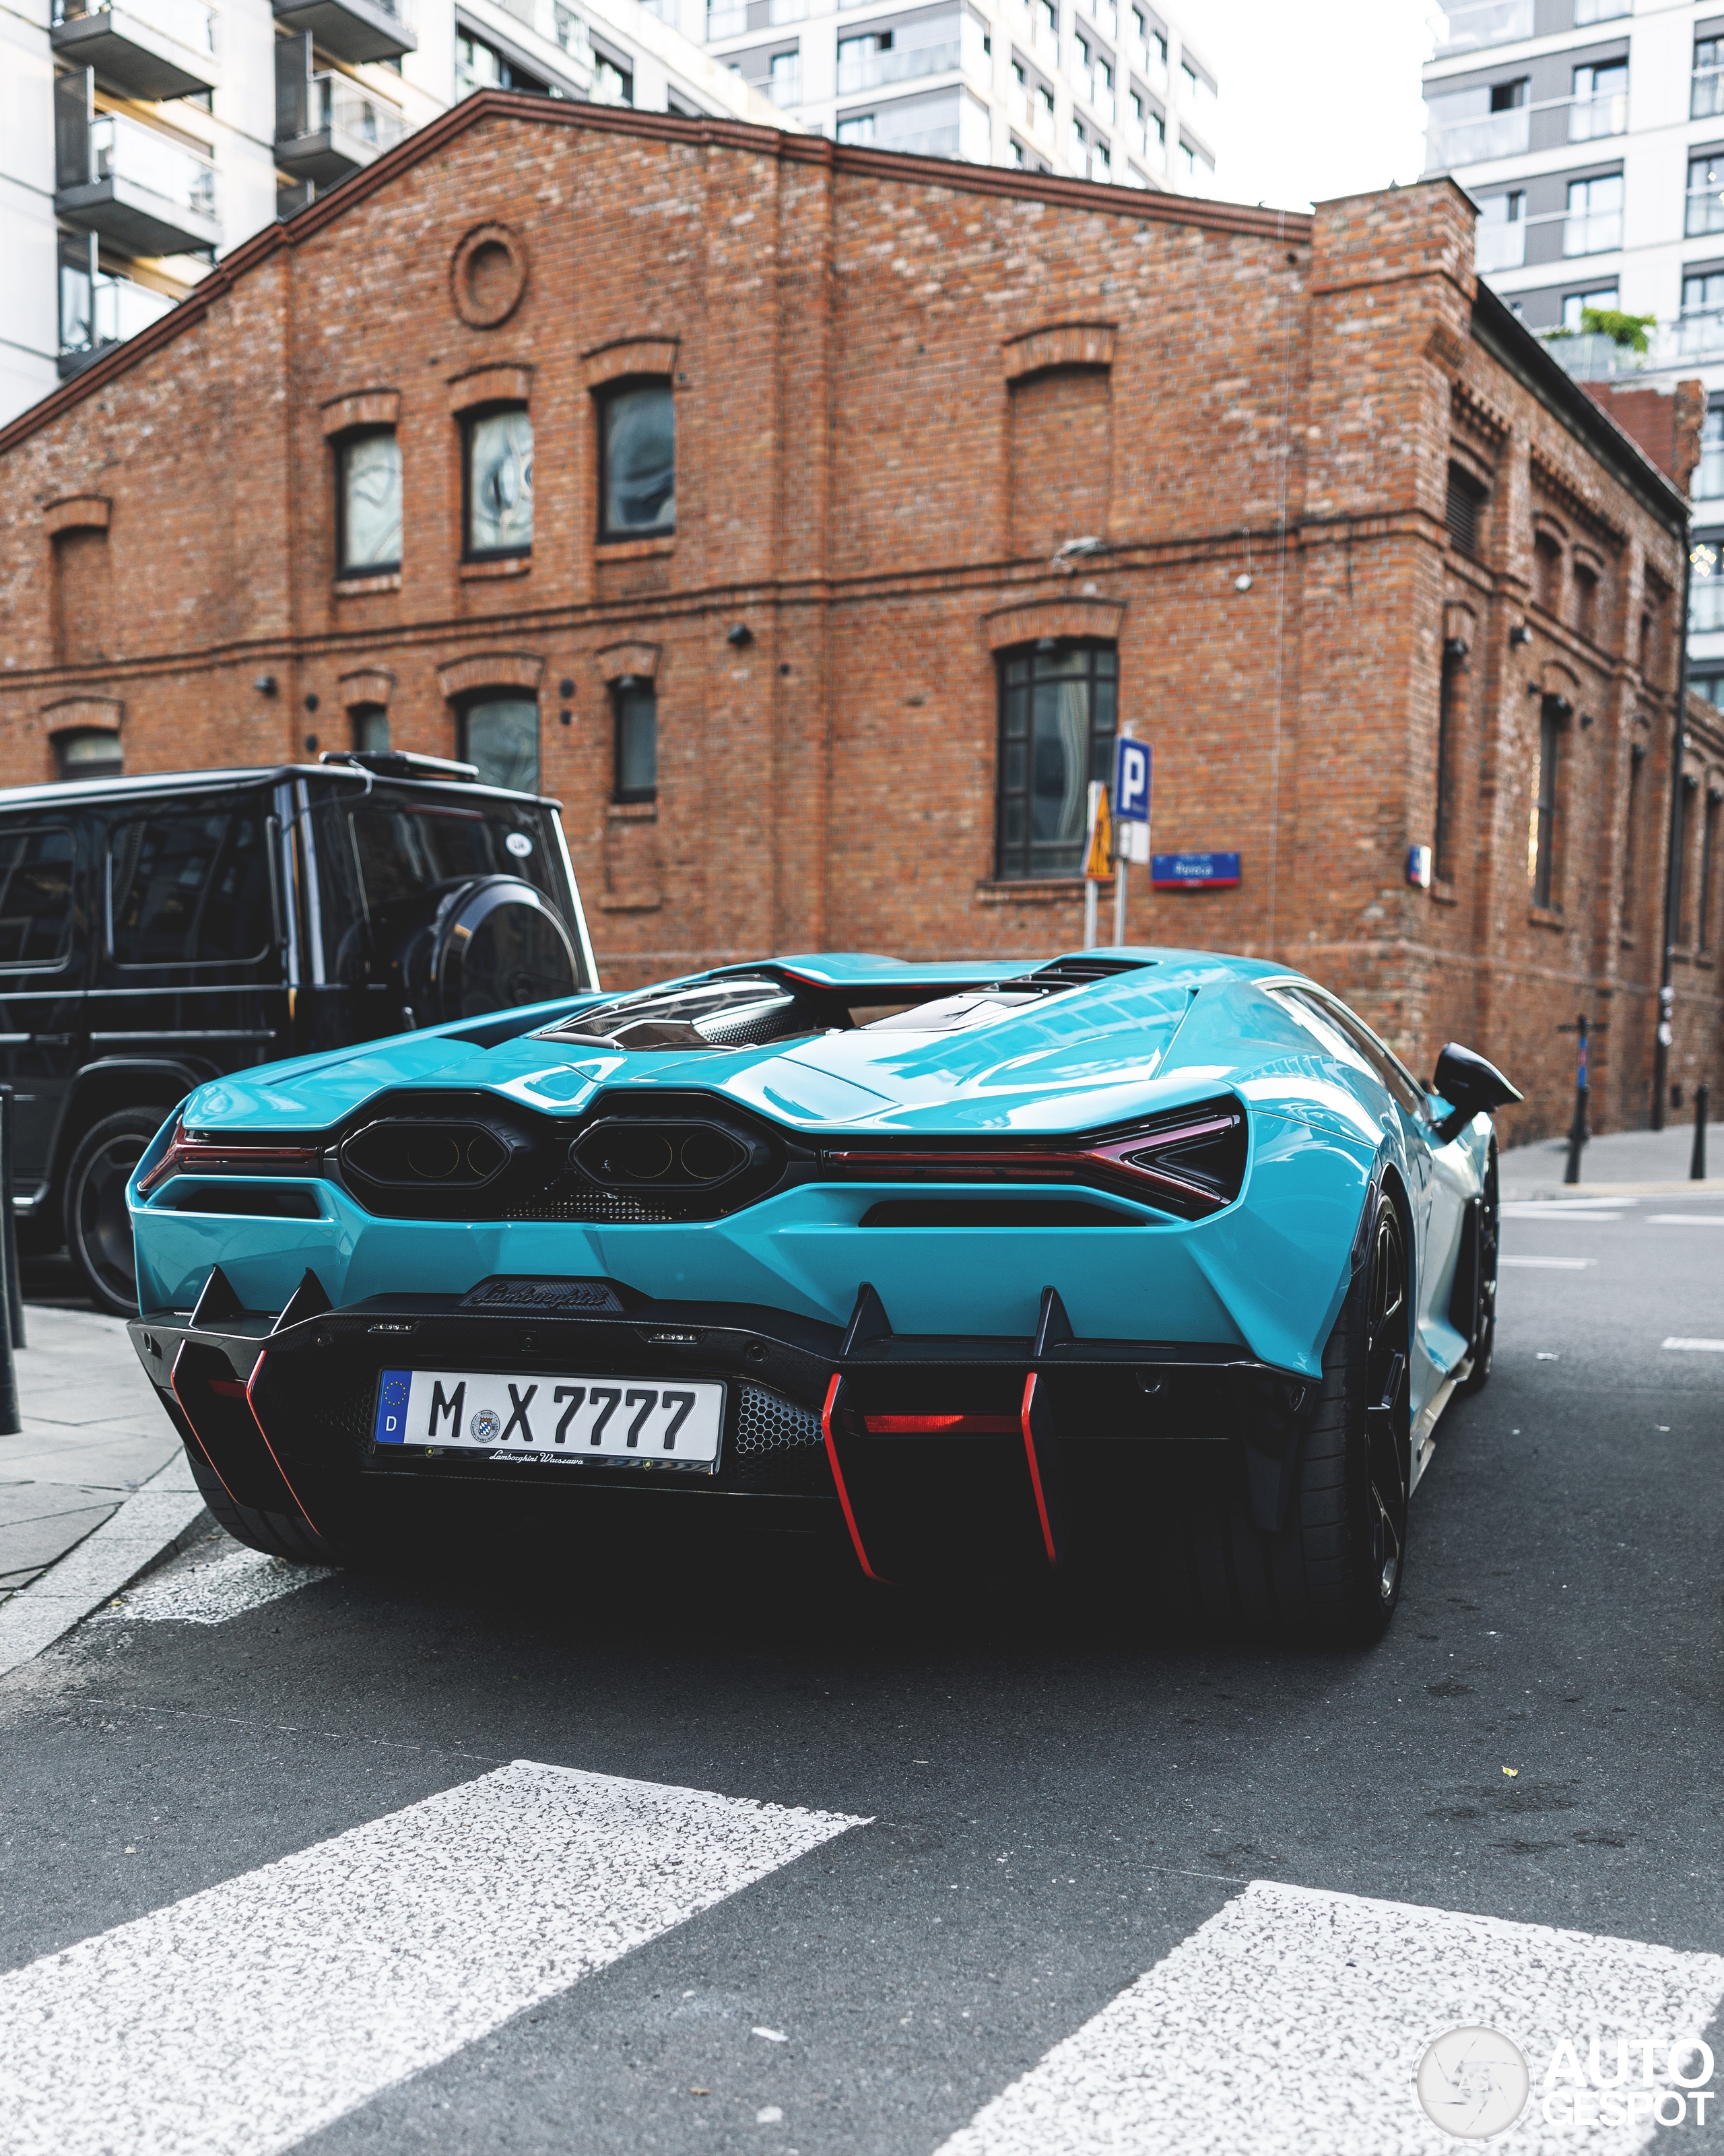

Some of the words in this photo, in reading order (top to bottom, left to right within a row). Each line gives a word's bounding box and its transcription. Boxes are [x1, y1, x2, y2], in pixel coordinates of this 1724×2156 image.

[1123, 748, 1145, 810] P
[471, 1282, 608, 1307] Lamborghini
[386, 1416, 397, 1431] D
[428, 1380, 466, 1438] M
[554, 1385, 696, 1449] 7777
[489, 1449, 538, 1463] Lamborghini
[539, 1452, 584, 1465] Warszawa
